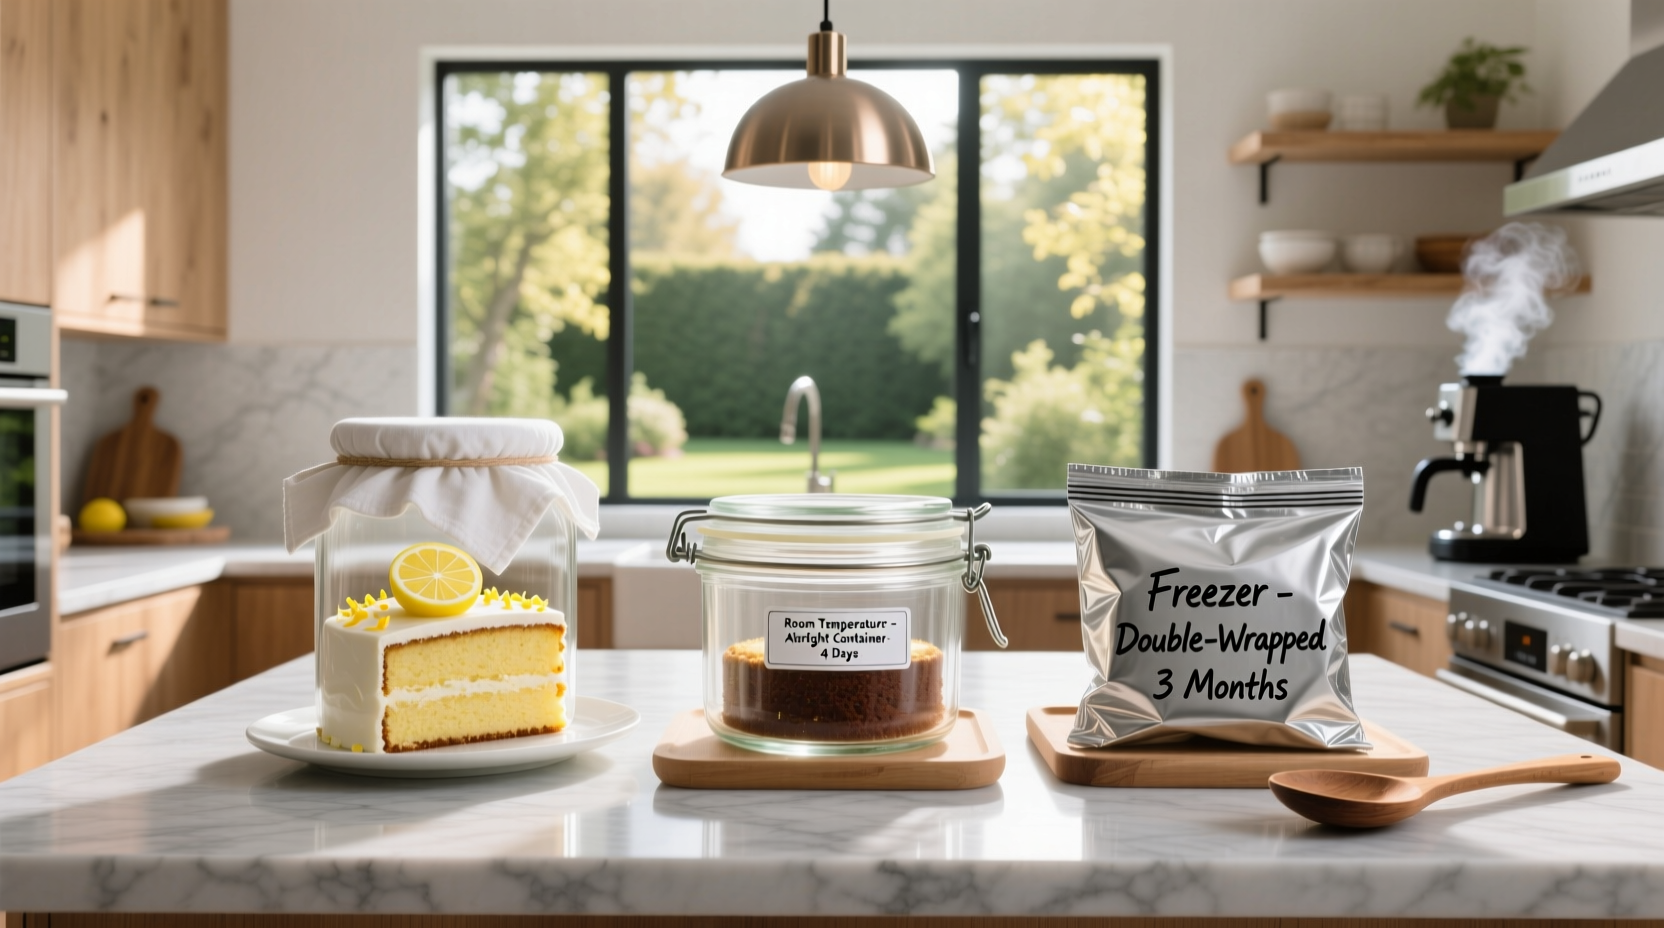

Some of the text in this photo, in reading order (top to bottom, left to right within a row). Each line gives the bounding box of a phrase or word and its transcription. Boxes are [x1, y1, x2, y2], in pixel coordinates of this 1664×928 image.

[1148, 567, 1268, 611] Freezer
[784, 617, 815, 629] Room
[820, 648, 828, 660] 4
[1115, 618, 1327, 664] Double-Wrapped
[1153, 668, 1288, 700] 3 Months
